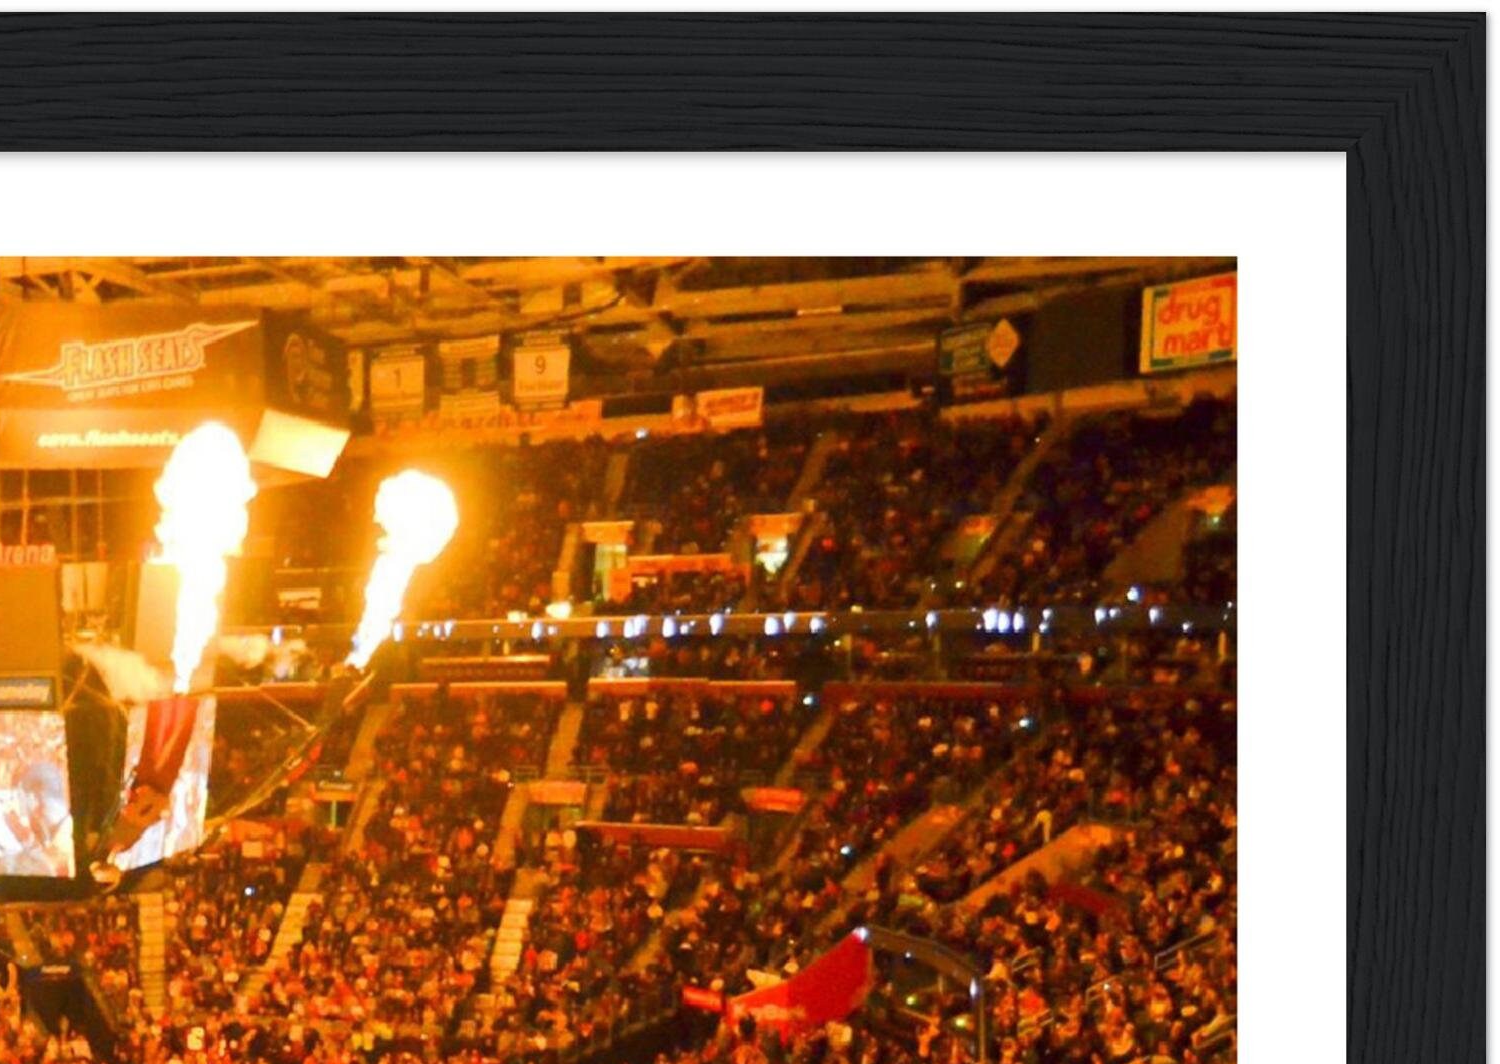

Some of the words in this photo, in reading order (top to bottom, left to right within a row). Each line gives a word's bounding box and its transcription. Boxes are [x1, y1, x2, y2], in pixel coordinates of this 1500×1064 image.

[1158, 288, 1220, 326] drug
[1163, 322, 1233, 355] mart
[62, 344, 134, 388] FLASH
[137, 333, 203, 375] SEATS
[534, 354, 547, 375] 9
